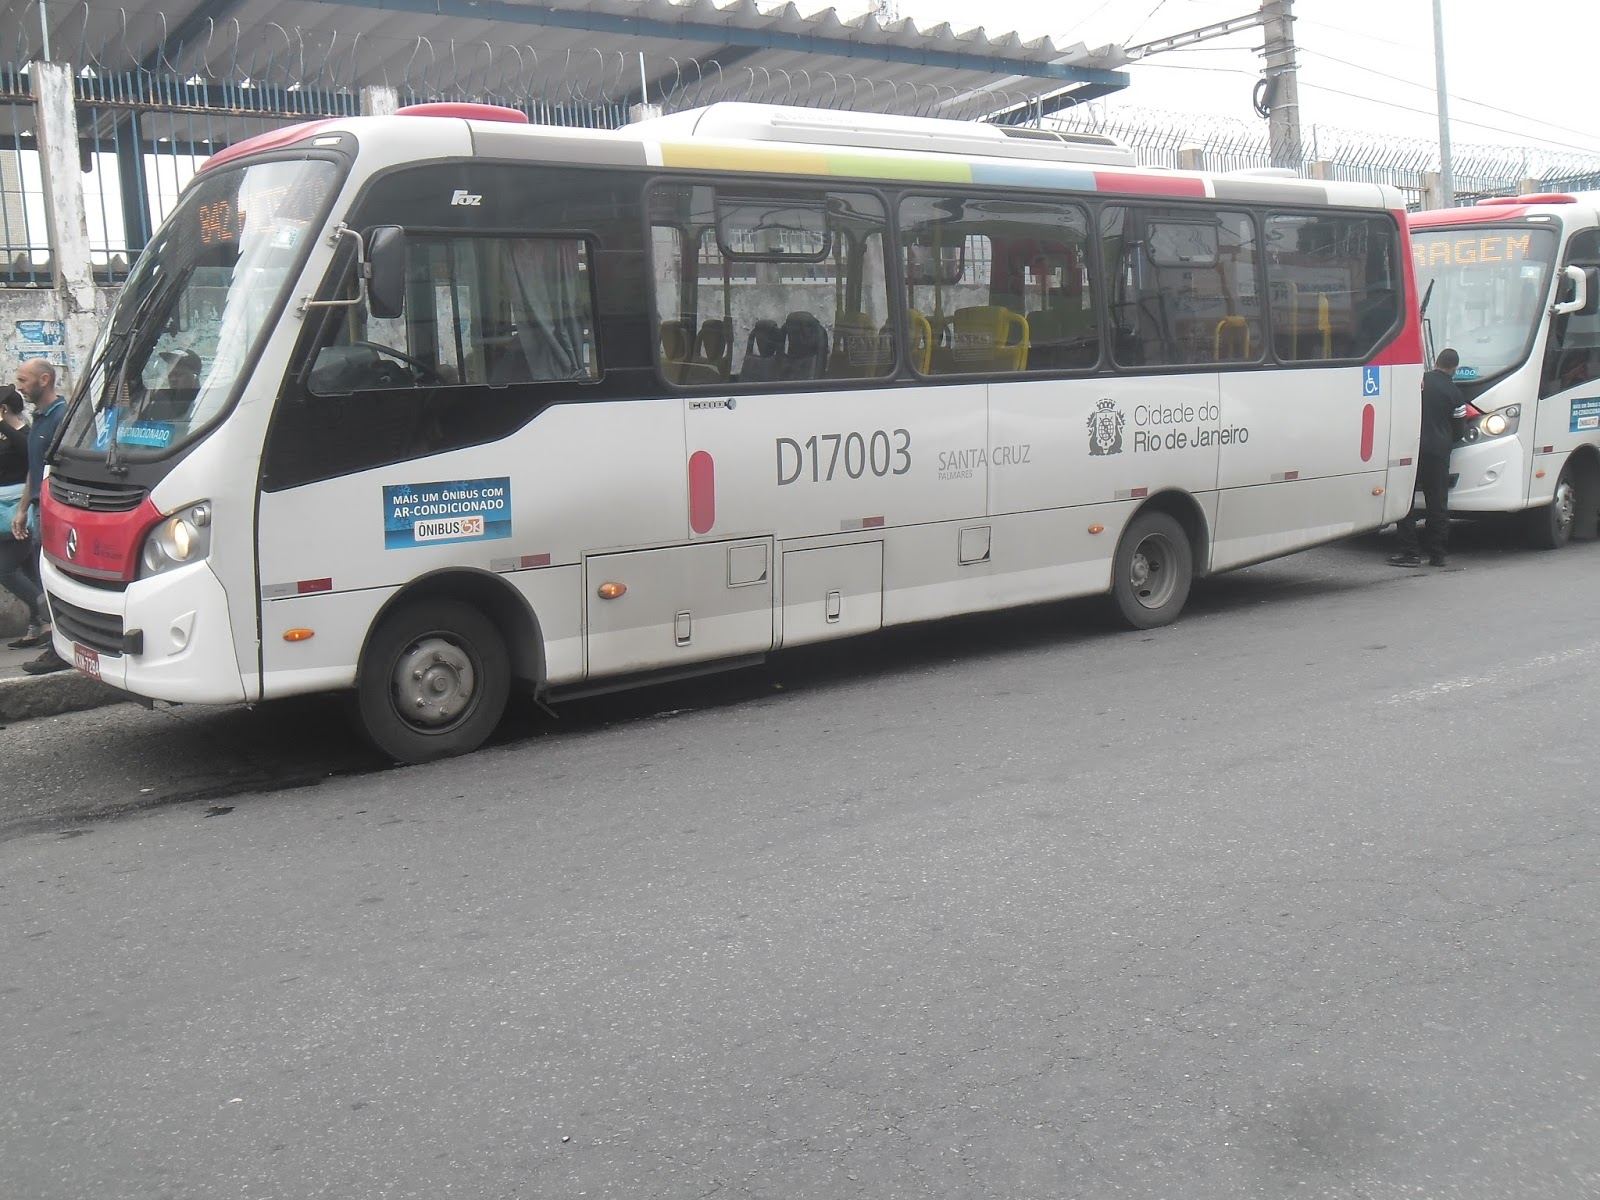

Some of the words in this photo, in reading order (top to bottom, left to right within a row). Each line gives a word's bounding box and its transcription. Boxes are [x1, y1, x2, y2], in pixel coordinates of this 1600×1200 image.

[199, 200, 233, 243] 842
[1134, 403, 1194, 426] Cidade
[1198, 401, 1219, 421] do
[1134, 430, 1162, 453] Rio
[1165, 428, 1188, 450] de
[1190, 424, 1249, 448] Janeiro
[776, 428, 912, 486] D17003
[938, 448, 989, 472] SANTA
[992, 444, 1031, 467] CRUZ
[938, 469, 973, 481] PALMARES
[393, 494, 419, 505] MAIS
[422, 492, 439, 503] UM
[442, 490, 479, 501] ÔNIBUS
[481, 487, 504, 498] COM
[393, 499, 504, 518] AR-CONDICIONADO
[418, 521, 460, 537] ÔNIBUS
